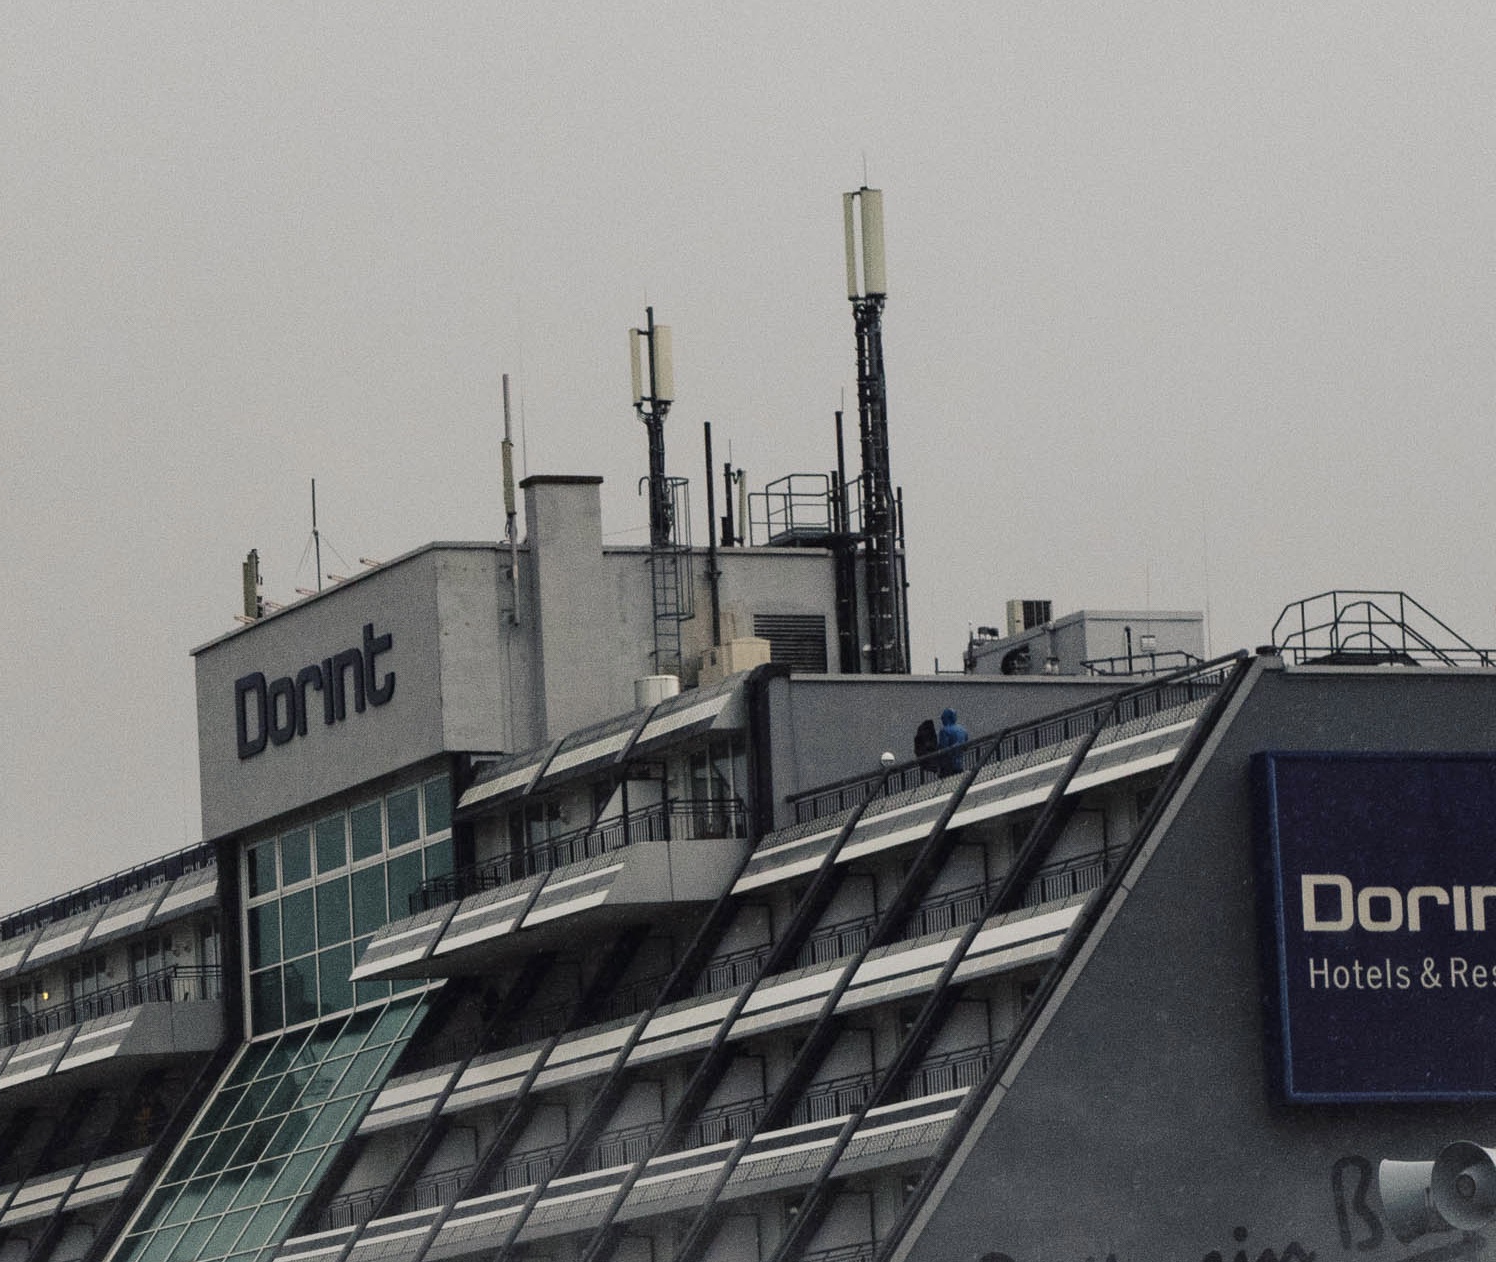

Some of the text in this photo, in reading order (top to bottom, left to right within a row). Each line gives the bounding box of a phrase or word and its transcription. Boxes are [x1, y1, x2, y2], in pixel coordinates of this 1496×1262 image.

[235, 623, 395, 760] Dorint
[1309, 956, 1496, 990] Hotels & Re
